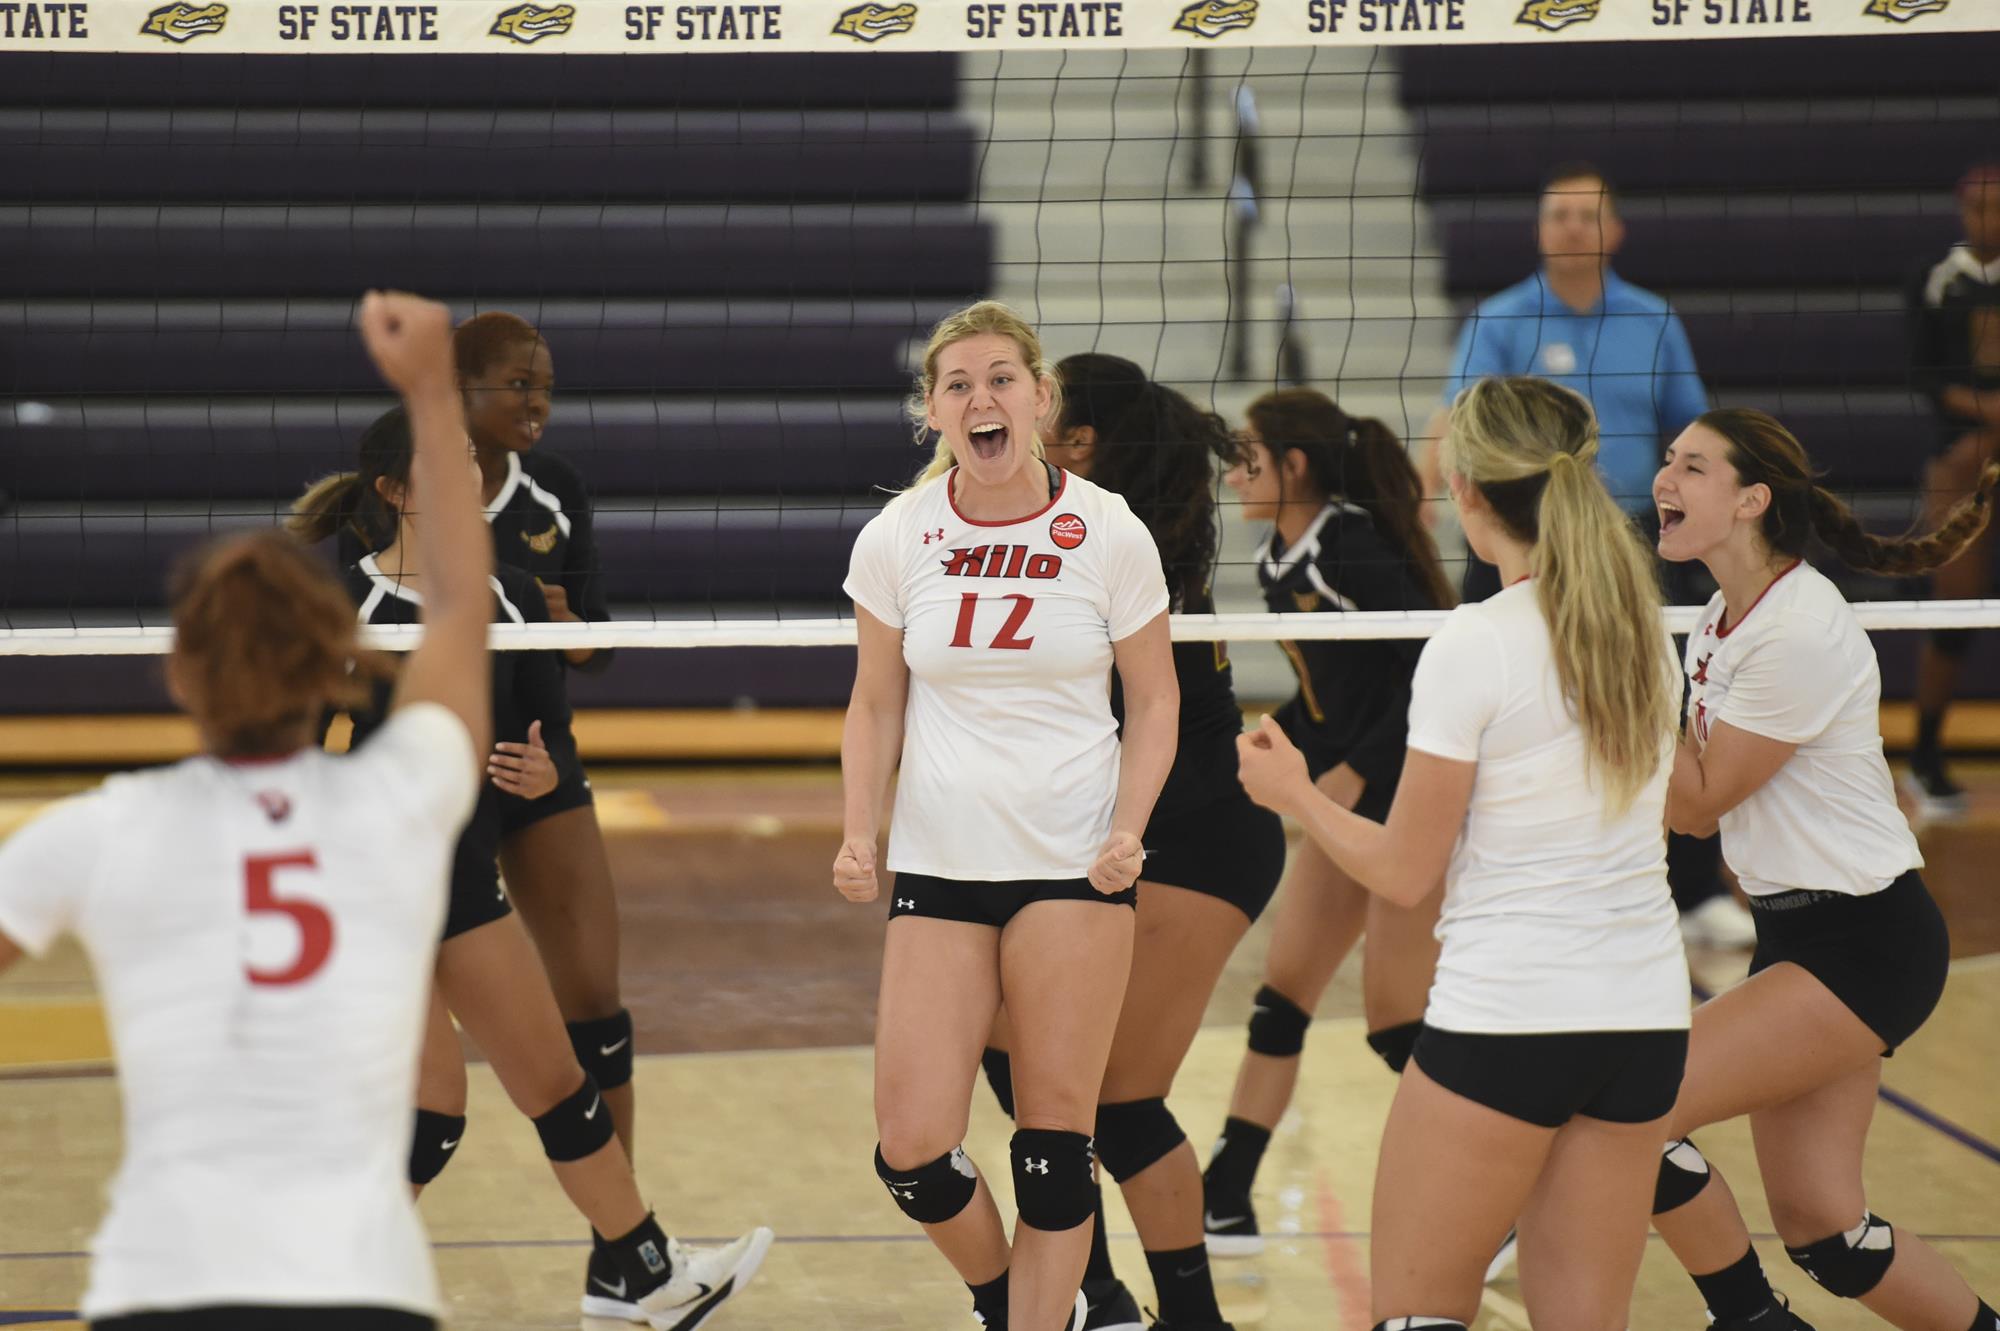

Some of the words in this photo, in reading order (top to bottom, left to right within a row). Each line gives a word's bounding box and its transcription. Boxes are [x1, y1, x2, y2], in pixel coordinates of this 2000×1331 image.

[279, 5, 319, 40] SF
[331, 5, 438, 41] STATE
[625, 6, 663, 41] SF
[676, 5, 781, 41] STATE
[967, 4, 1005, 39] SF
[1017, 3, 1123, 38] STATE
[1308, 0, 1347, 33] SF
[1359, 0, 1465, 32] STATE
[1652, 0, 1689, 26] SF
[1052, 529, 1084, 540] PacWest
[940, 544, 1063, 580] Hilo
[948, 592, 1036, 650] 12
[242, 849, 337, 988] 5
